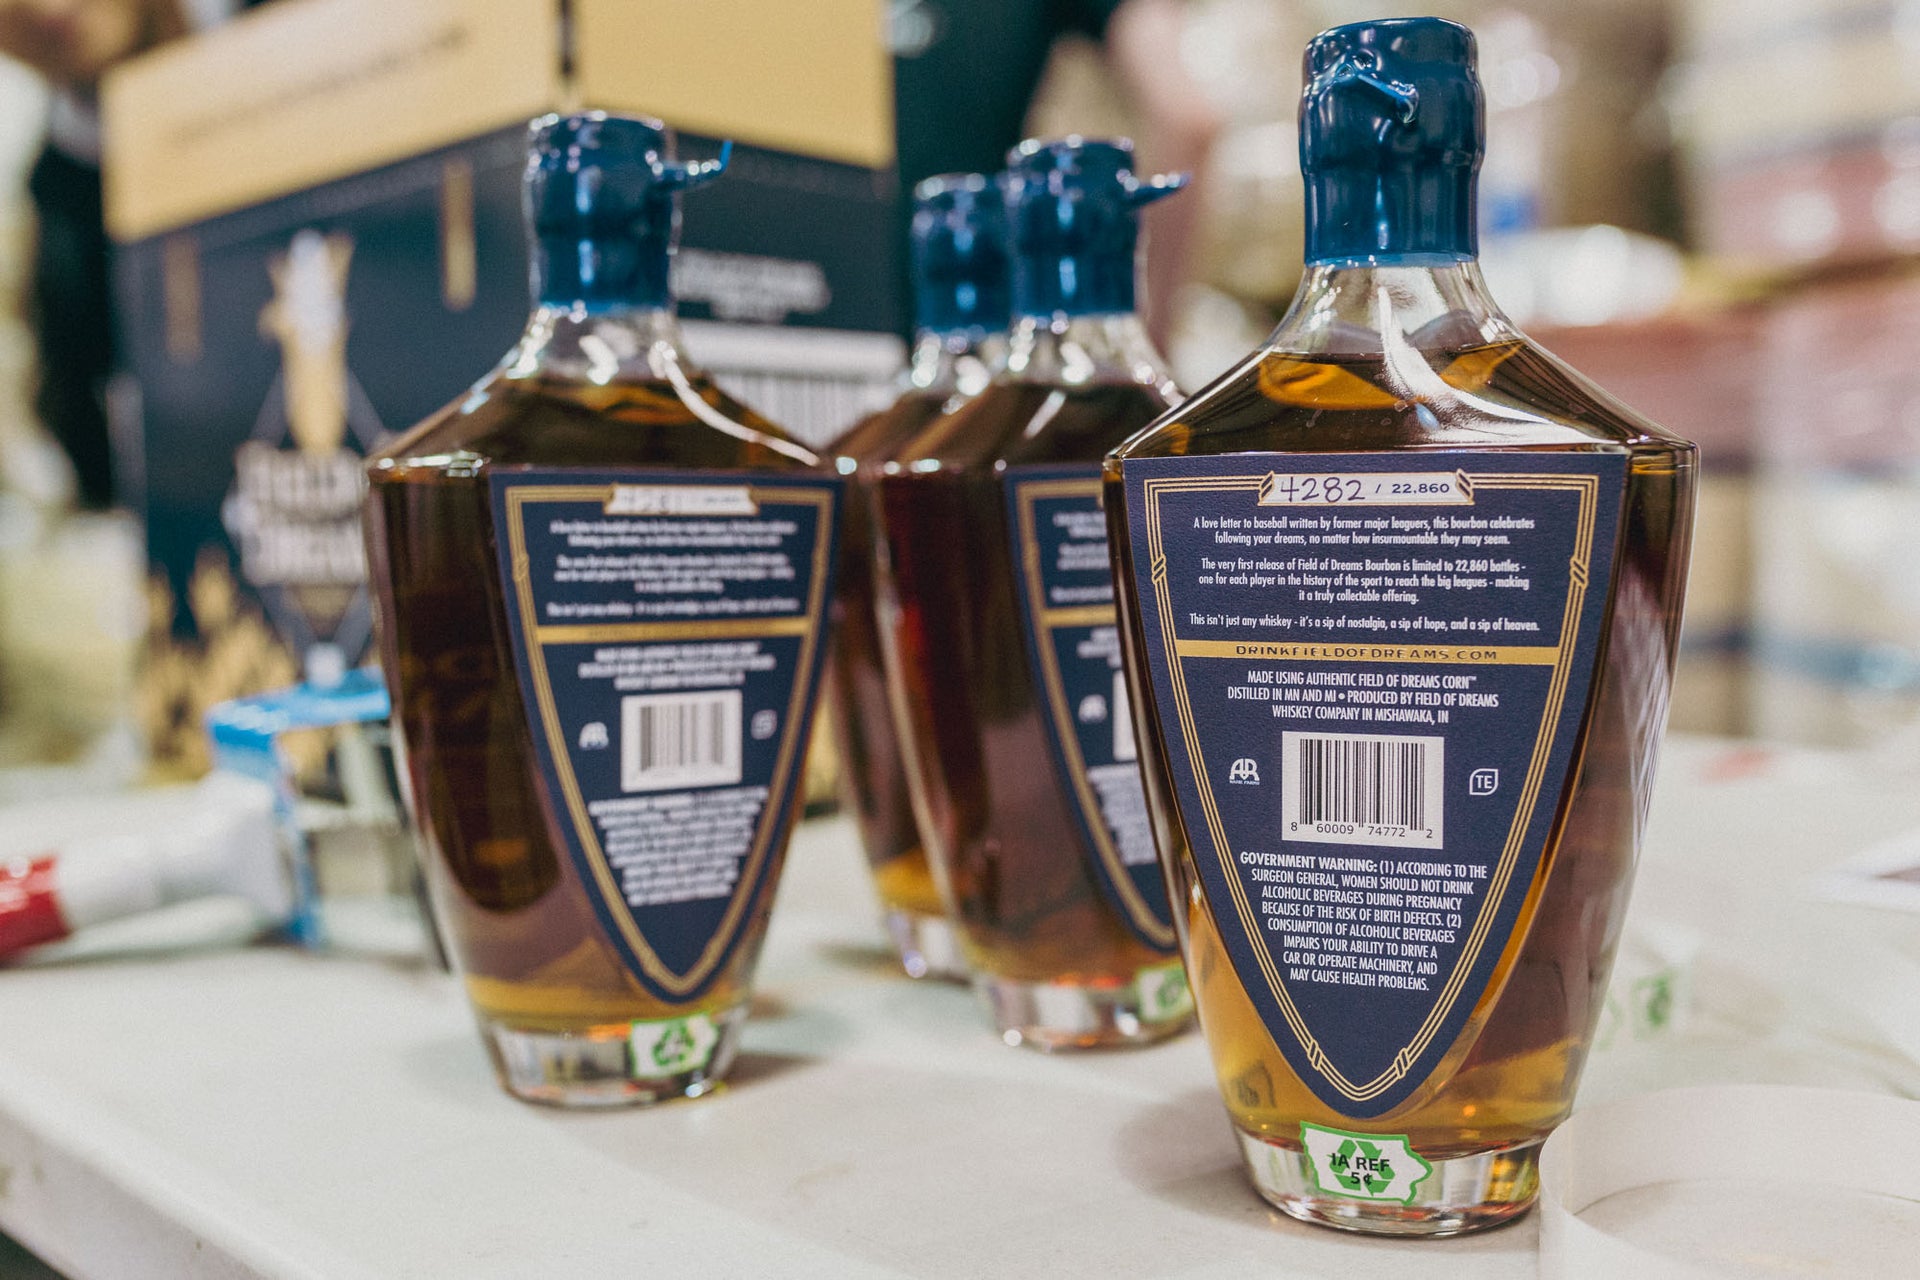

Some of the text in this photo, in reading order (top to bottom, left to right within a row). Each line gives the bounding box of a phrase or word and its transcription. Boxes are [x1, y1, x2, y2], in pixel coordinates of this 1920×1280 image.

[1281, 476, 1366, 502] 4282
[1193, 515, 1535, 532] A love letter to baseball written by former major leaguers, this bourbon celebrates
[1214, 530, 1510, 547] following your dreams, no matter how insurmountable they may seem.
[1202, 557, 1216, 570] The
[1217, 561, 1236, 572] very
[1237, 557, 1254, 570] first
[1255, 557, 1285, 571] release
[1286, 557, 1296, 571] of
[1297, 557, 1317, 571] Field
[1319, 557, 1329, 571] of
[1330, 558, 1363, 571] Dreams
[1364, 558, 1401, 572] Bourbon
[1402, 559, 1410, 572] is
[1411, 558, 1442, 572] limited
[1443, 560, 1453, 572] to
[1454, 559, 1488, 574] 22,860
[1489, 558, 1520, 573] bottles
[1198, 575, 1214, 585] one
[1215, 571, 1227, 585] for
[1228, 572, 1248, 585] each
[1249, 572, 1276, 588] player
[1277, 574, 1286, 585] in
[1287, 572, 1301, 586] the
[1302, 572, 1332, 589] history
[1333, 573, 1343, 586] of
[1344, 573, 1359, 586] the
[1360, 575, 1382, 589] sport
[1383, 576, 1394, 587] to
[1394, 573, 1419, 587] reach
[1420, 573, 1435, 587] the
[1436, 573, 1451, 590] big
[1452, 574, 1487, 590] leagues
[1494, 574, 1529, 591] making
[1298, 588, 1419, 605] it a truly collectable offering.
[1190, 612, 1205, 625] This
[1206, 613, 1224, 625] isn't
[1225, 614, 1240, 628] just
[1241, 617, 1257, 629] any
[1258, 613, 1292, 630] whiskey
[1299, 615, 1313, 628] it's
[1314, 618, 1320, 628] a
[1321, 616, 1334, 631] sip
[1335, 614, 1346, 628] of
[1347, 615, 1388, 632] nostalgia,
[1389, 619, 1396, 629] a
[1397, 617, 1411, 632] sip
[1411, 615, 1422, 630] of
[1423, 616, 1448, 633] hope,
[1449, 616, 1468, 630] and
[1468, 621, 1476, 630] a
[1476, 618, 1491, 633] sip
[1491, 617, 1502, 631] of
[1503, 617, 1540, 631] heaven.
[1235, 645, 1496, 660] DRINKFIELDOFDREAMS.COM
[1247, 670, 1273, 683] MADE
[1275, 671, 1304, 684] USING
[1305, 671, 1355, 686] AUTHENTIC
[1358, 673, 1384, 686] FIELD
[1385, 673, 1399, 687] OF
[1400, 674, 1440, 688] DREAMS
[1227, 686, 1499, 707] DISTILLED IN MN AND MI PRODUCED BY FIELD OF DREAMS
[1272, 704, 1449, 725] WHISKEY COMPANY IN MISHAWAKA, IN
[1475, 775, 1493, 789] TE
[1290, 821, 1433, 839] 8 60009 74772 2
[1239, 851, 1487, 878] GOVERNMENT WARNING: (1) ACCORDING TO THE
[1251, 867, 1473, 894] SURGEON GENERAL, WOMEN SHOULD NOT DRINK
[1261, 884, 1461, 910] ALCOHOLIC BEVERAGES DURING PREGNANCY
[1261, 900, 1461, 928] BECAUSE OF THE RISK OF BIRTH DEFECTS. (2)
[1267, 917, 1455, 943] CONSUMPTION OF ALCOHOLIC BEVERAGES
[1283, 934, 1437, 958] IMPAIRS YOUR ABILITY TO DRIVE A
[1282, 950, 1437, 975] CAR OR OPERATE MACHINERY, AND
[1289, 967, 1429, 990] MAY CAUSE HEALTH PROBLEMS.
[1331, 1152, 1390, 1172] IA REF
[1350, 1171, 1373, 1187] 5¢
